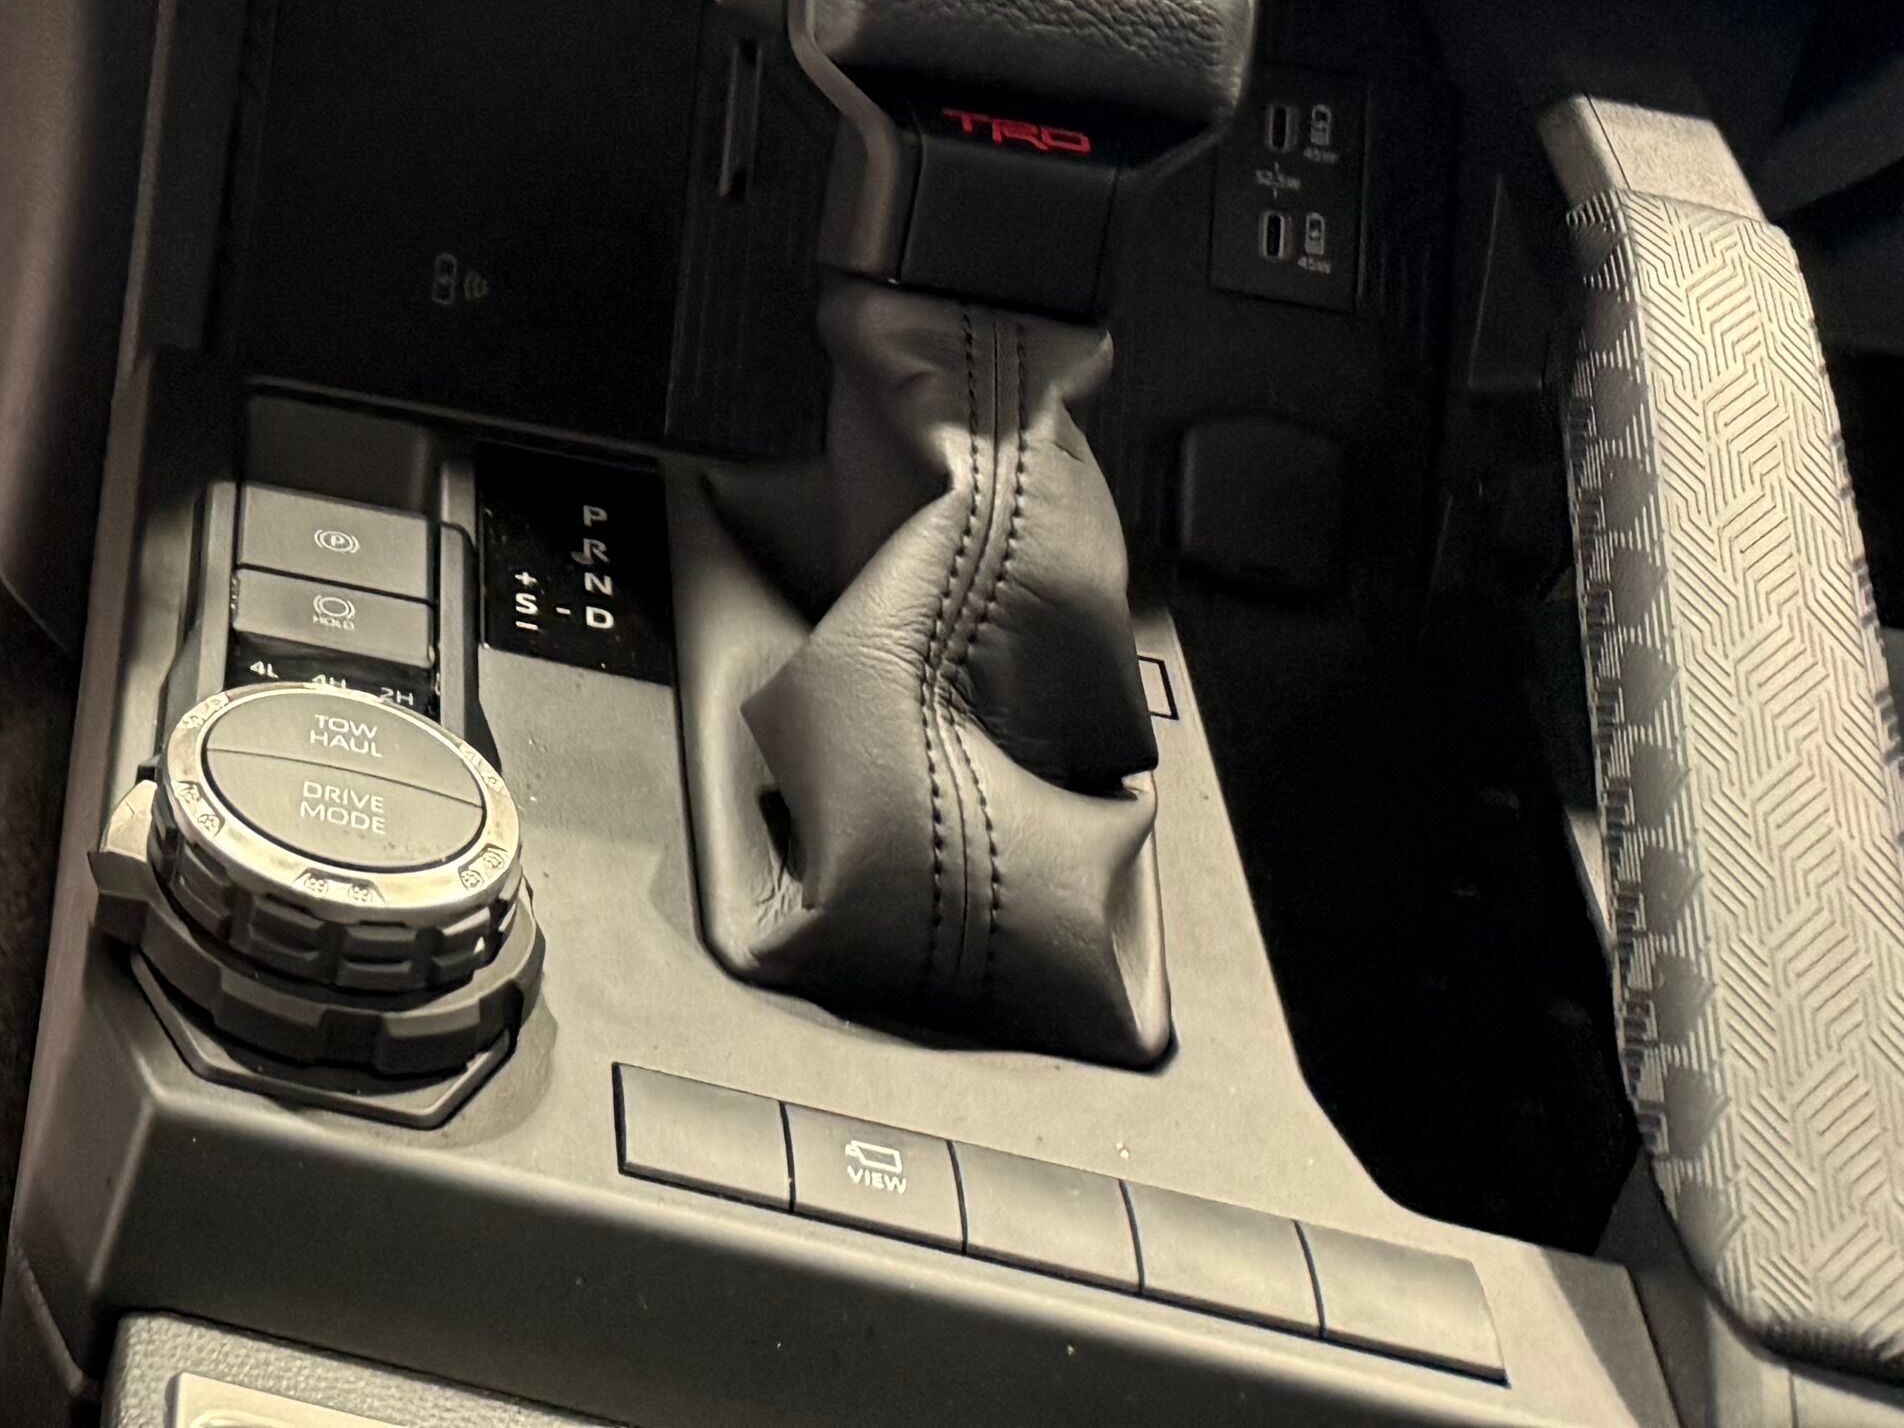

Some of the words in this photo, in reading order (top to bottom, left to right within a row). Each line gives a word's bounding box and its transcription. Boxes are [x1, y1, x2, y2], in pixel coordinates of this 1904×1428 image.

[943, 107, 1091, 155] TRD
[582, 505, 608, 527] P
[583, 539, 610, 564] R
[584, 572, 613, 597] N
[586, 607, 615, 631] D
[249, 660, 279, 679] 4L
[314, 712, 379, 739] TOW
[309, 730, 383, 759] HAUL
[302, 780, 385, 813] DRIVE
[299, 800, 387, 835] MODE
[846, 1164, 907, 1195] VIEW
